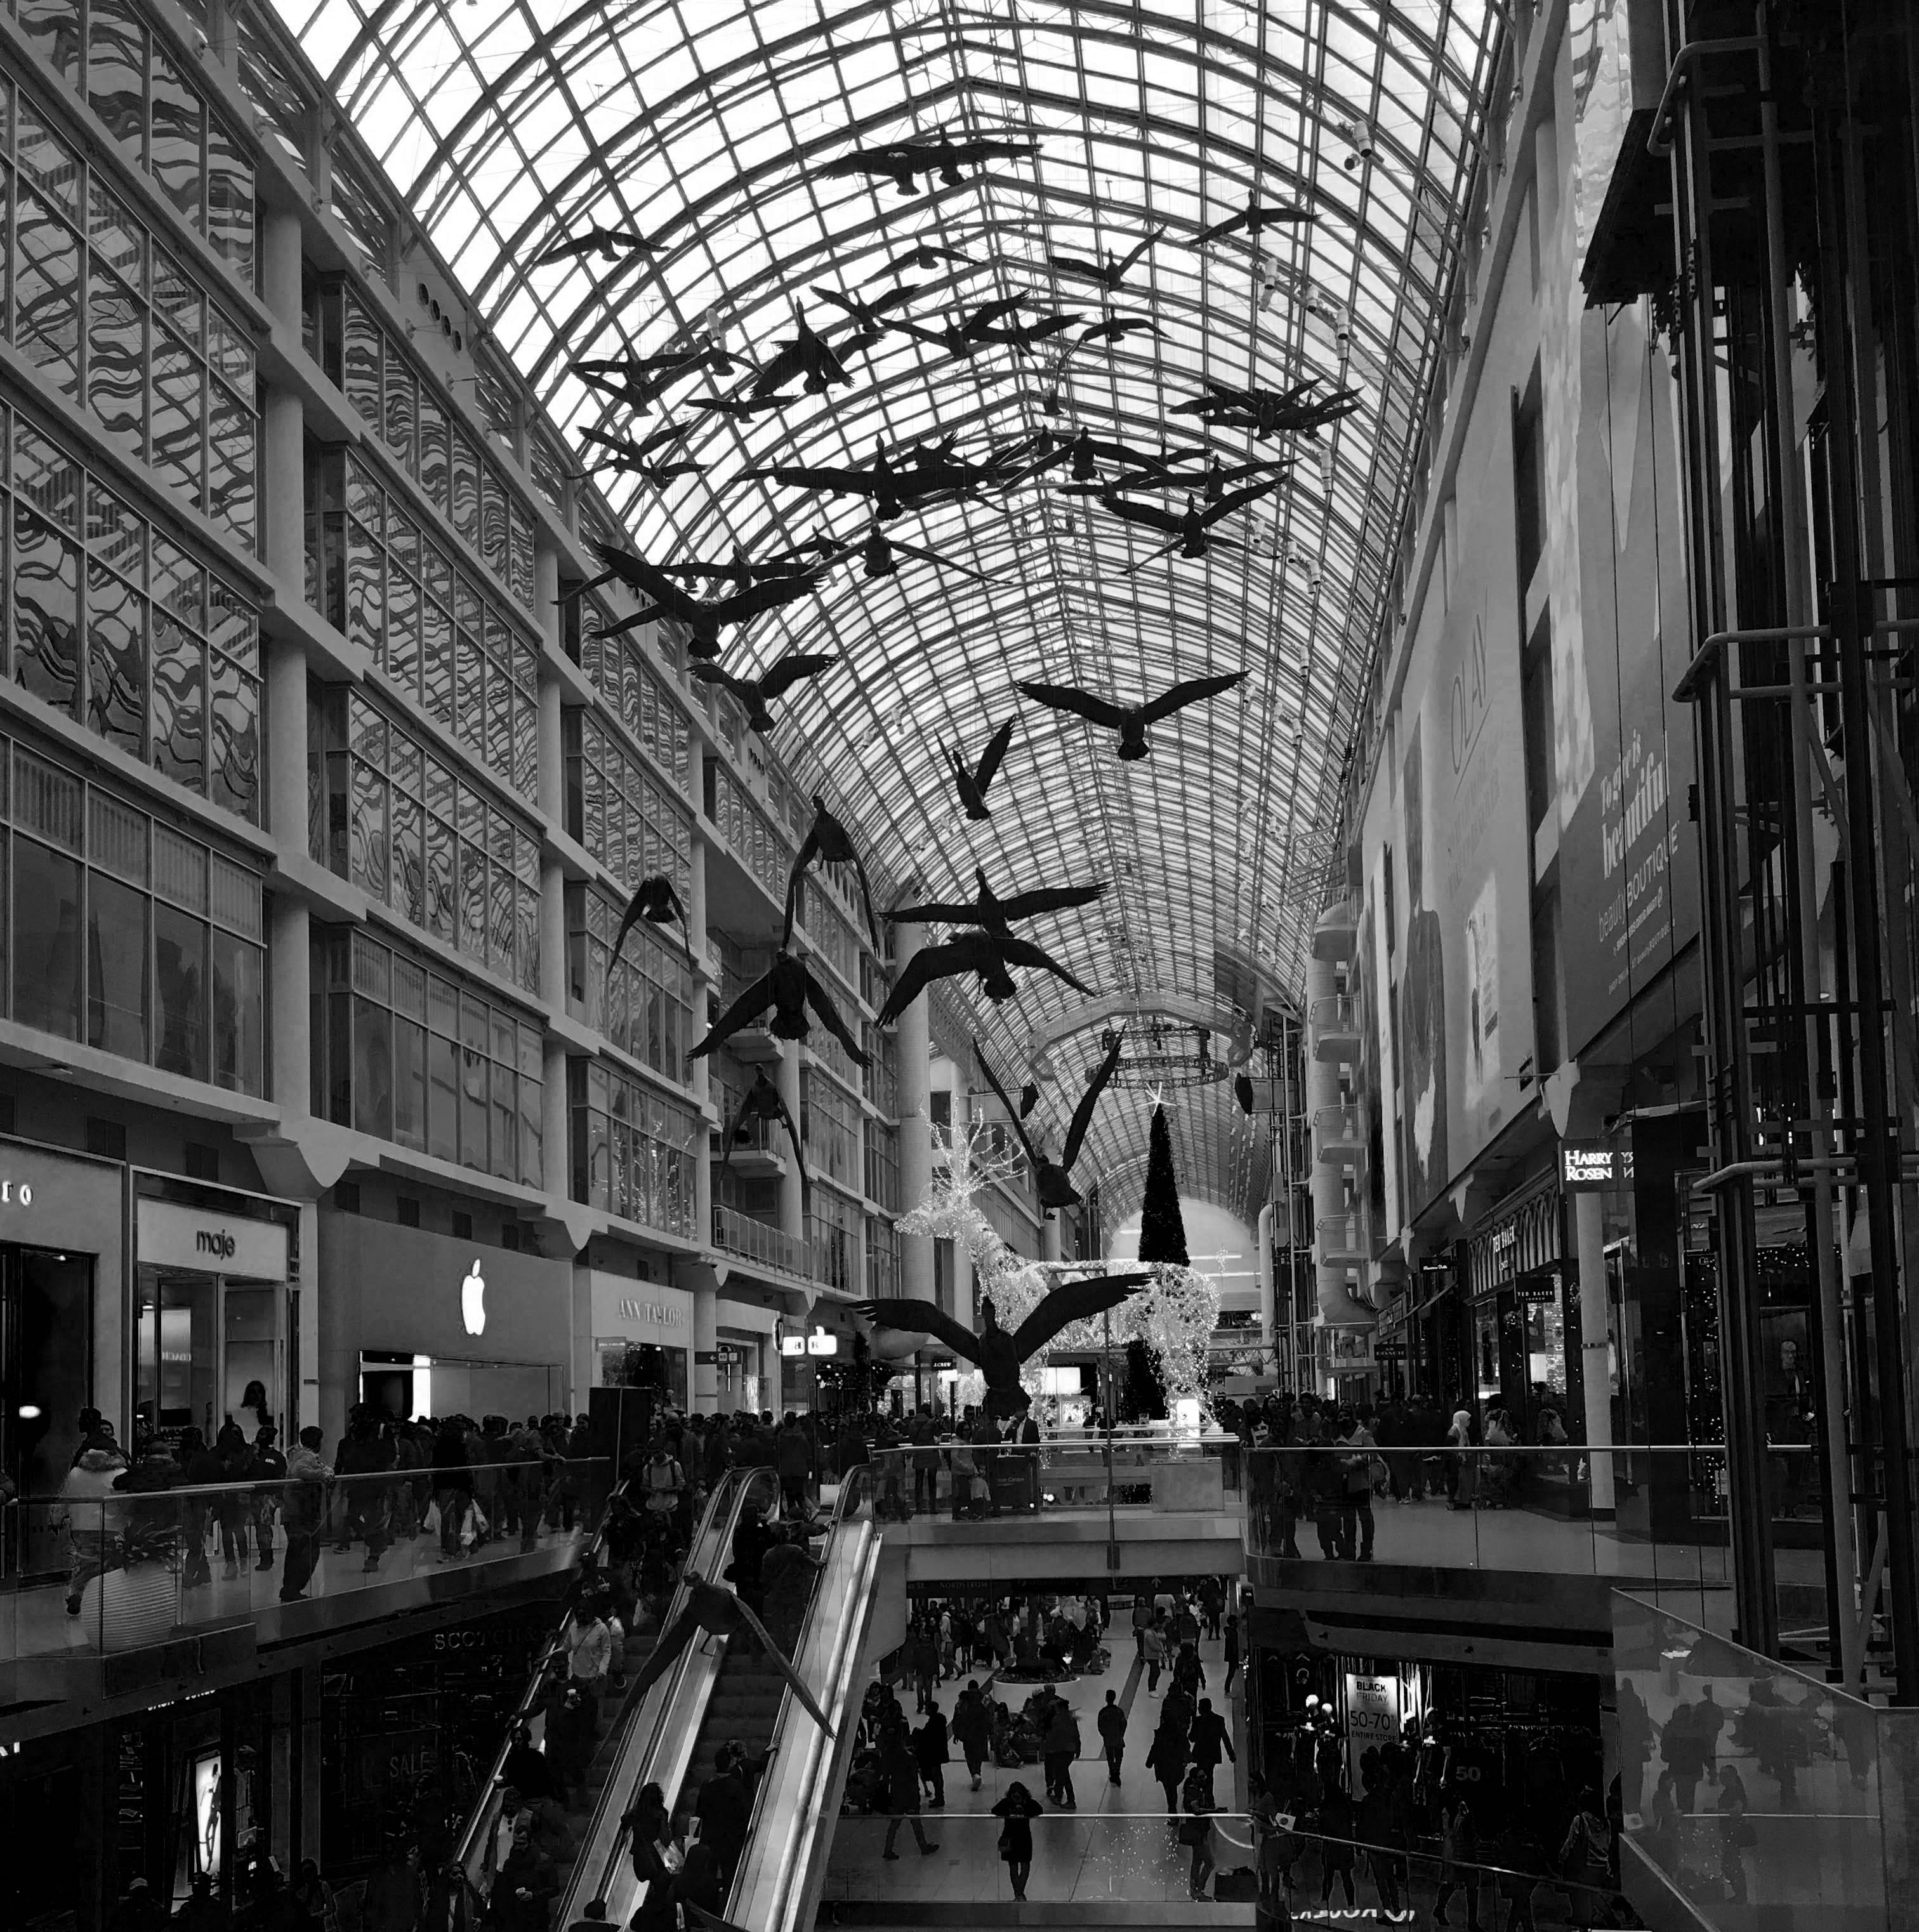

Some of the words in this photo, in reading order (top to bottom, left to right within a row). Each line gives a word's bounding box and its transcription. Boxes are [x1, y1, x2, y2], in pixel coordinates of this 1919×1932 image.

[1600, 775, 1612, 817] To
[1632, 728, 1641, 769] is
[1602, 730, 1670, 880] beautiful
[1564, 1150, 1613, 1166] HARRY
[1565, 1166, 1612, 1181] ROSEN
[197, 1228, 235, 1261] maje
[619, 1299, 640, 1320] ANN
[645, 1303, 682, 1327] TAYLOR
[1356, 1681, 1386, 1692] BLACK
[1356, 1692, 1388, 1703] FRIDAY
[1352, 1730, 1375, 1740] ENTIRE
[1375, 1733, 1397, 1743] STORE
[390, 1752, 433, 1777] SALE
[1456, 1766, 1481, 1782] 50
